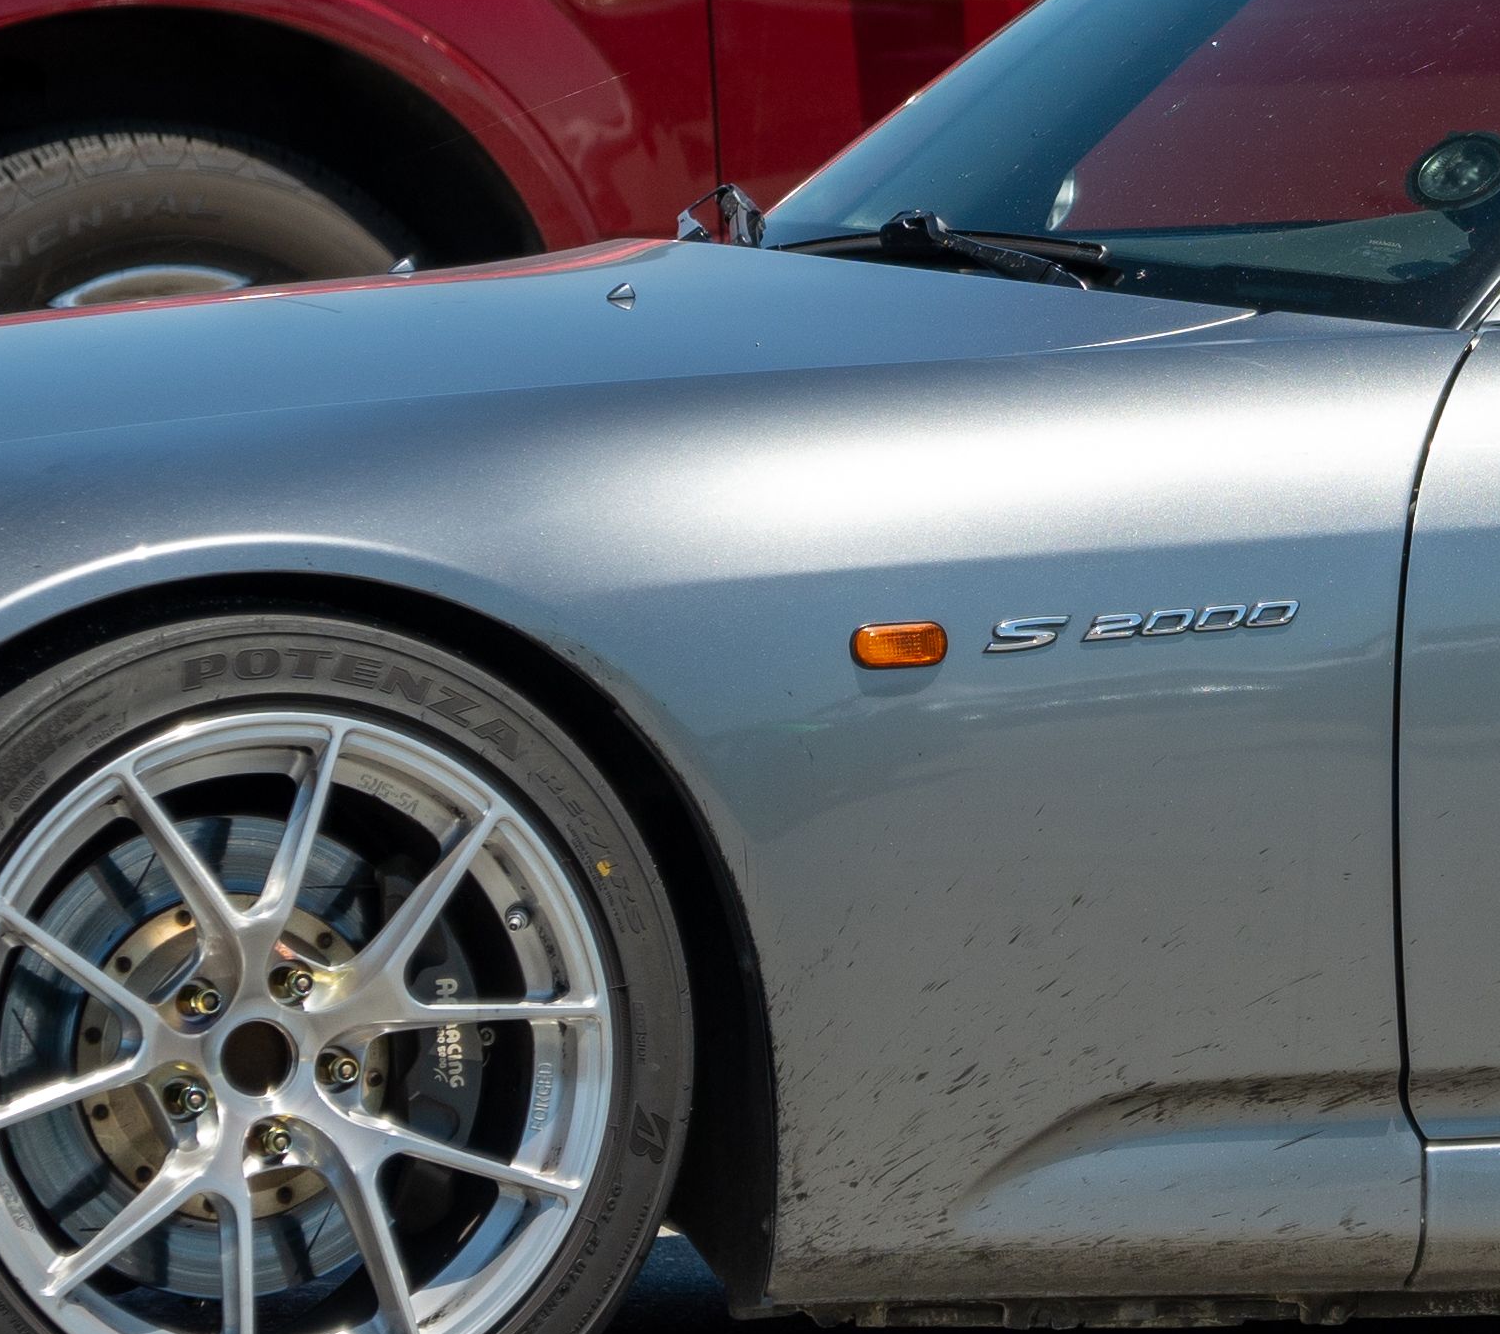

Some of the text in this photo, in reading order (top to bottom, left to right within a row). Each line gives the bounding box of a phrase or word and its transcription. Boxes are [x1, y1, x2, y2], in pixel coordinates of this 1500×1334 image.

[982, 599, 1300, 654] S 2000
[174, 644, 533, 768] POTENZA
[530, 1061, 555, 1133] FORGED
